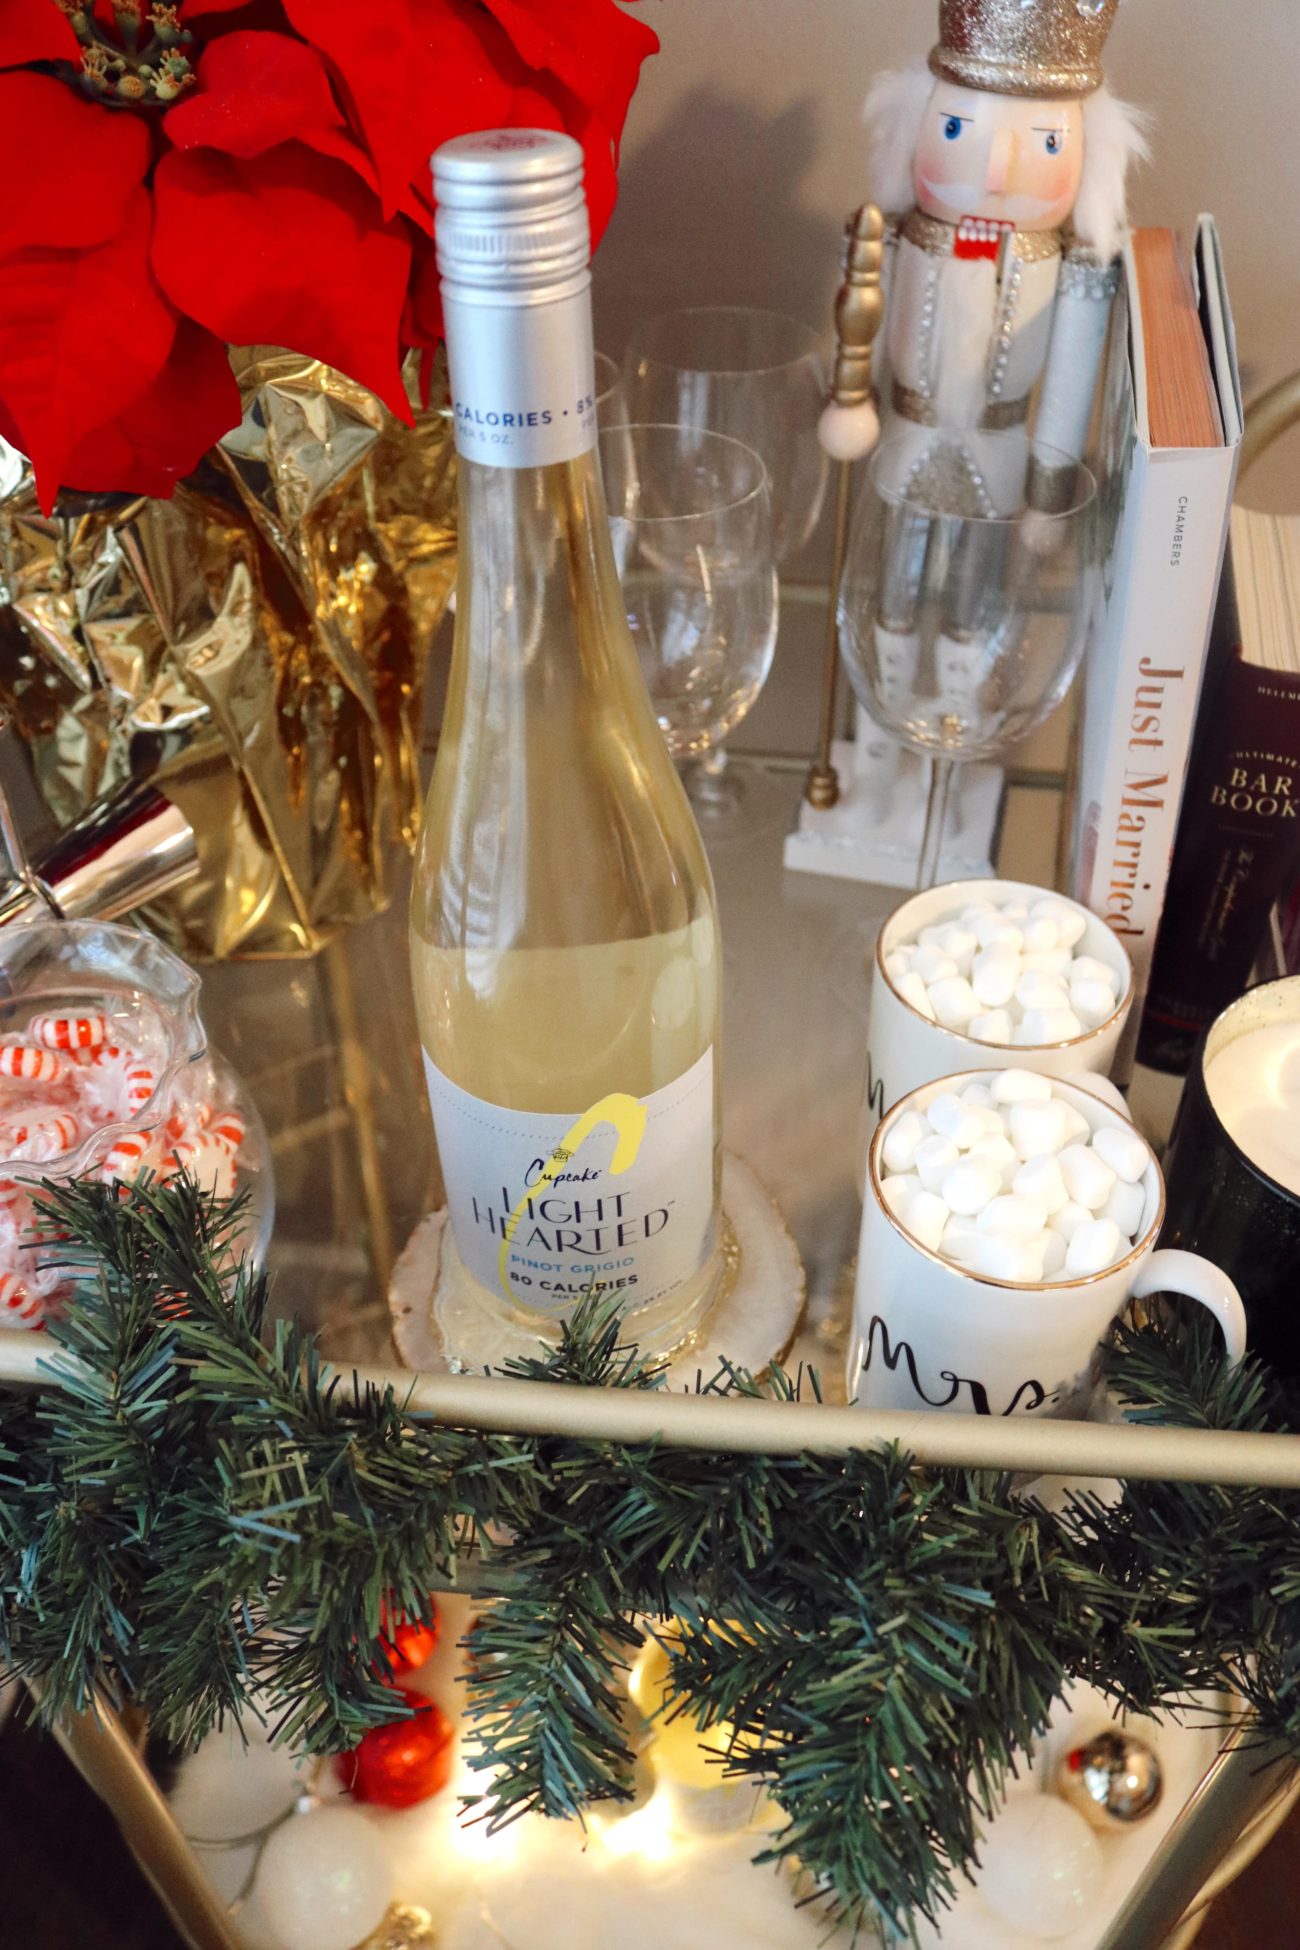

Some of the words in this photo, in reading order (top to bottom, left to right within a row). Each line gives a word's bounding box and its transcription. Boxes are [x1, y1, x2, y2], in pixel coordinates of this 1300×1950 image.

[456, 402, 553, 427] CALORIES
[1170, 495, 1188, 567] CHAMBERS
[1128, 656, 1185, 752] Just
[1230, 767, 1293, 796] BAR
[1211, 785, 1300, 818] BOOK
[1103, 769, 1170, 937] Married
[524, 1158, 602, 1188] Cupcake
[502, 1186, 630, 1224] LIGHT
[472, 1197, 669, 1256] HEARTED
[511, 1254, 563, 1273] PINOT
[570, 1256, 635, 1274] GRIGIO
[509, 1271, 533, 1286] 80
[539, 1274, 639, 1293] CALORIES
[862, 1315, 1060, 1416] Mrs.
